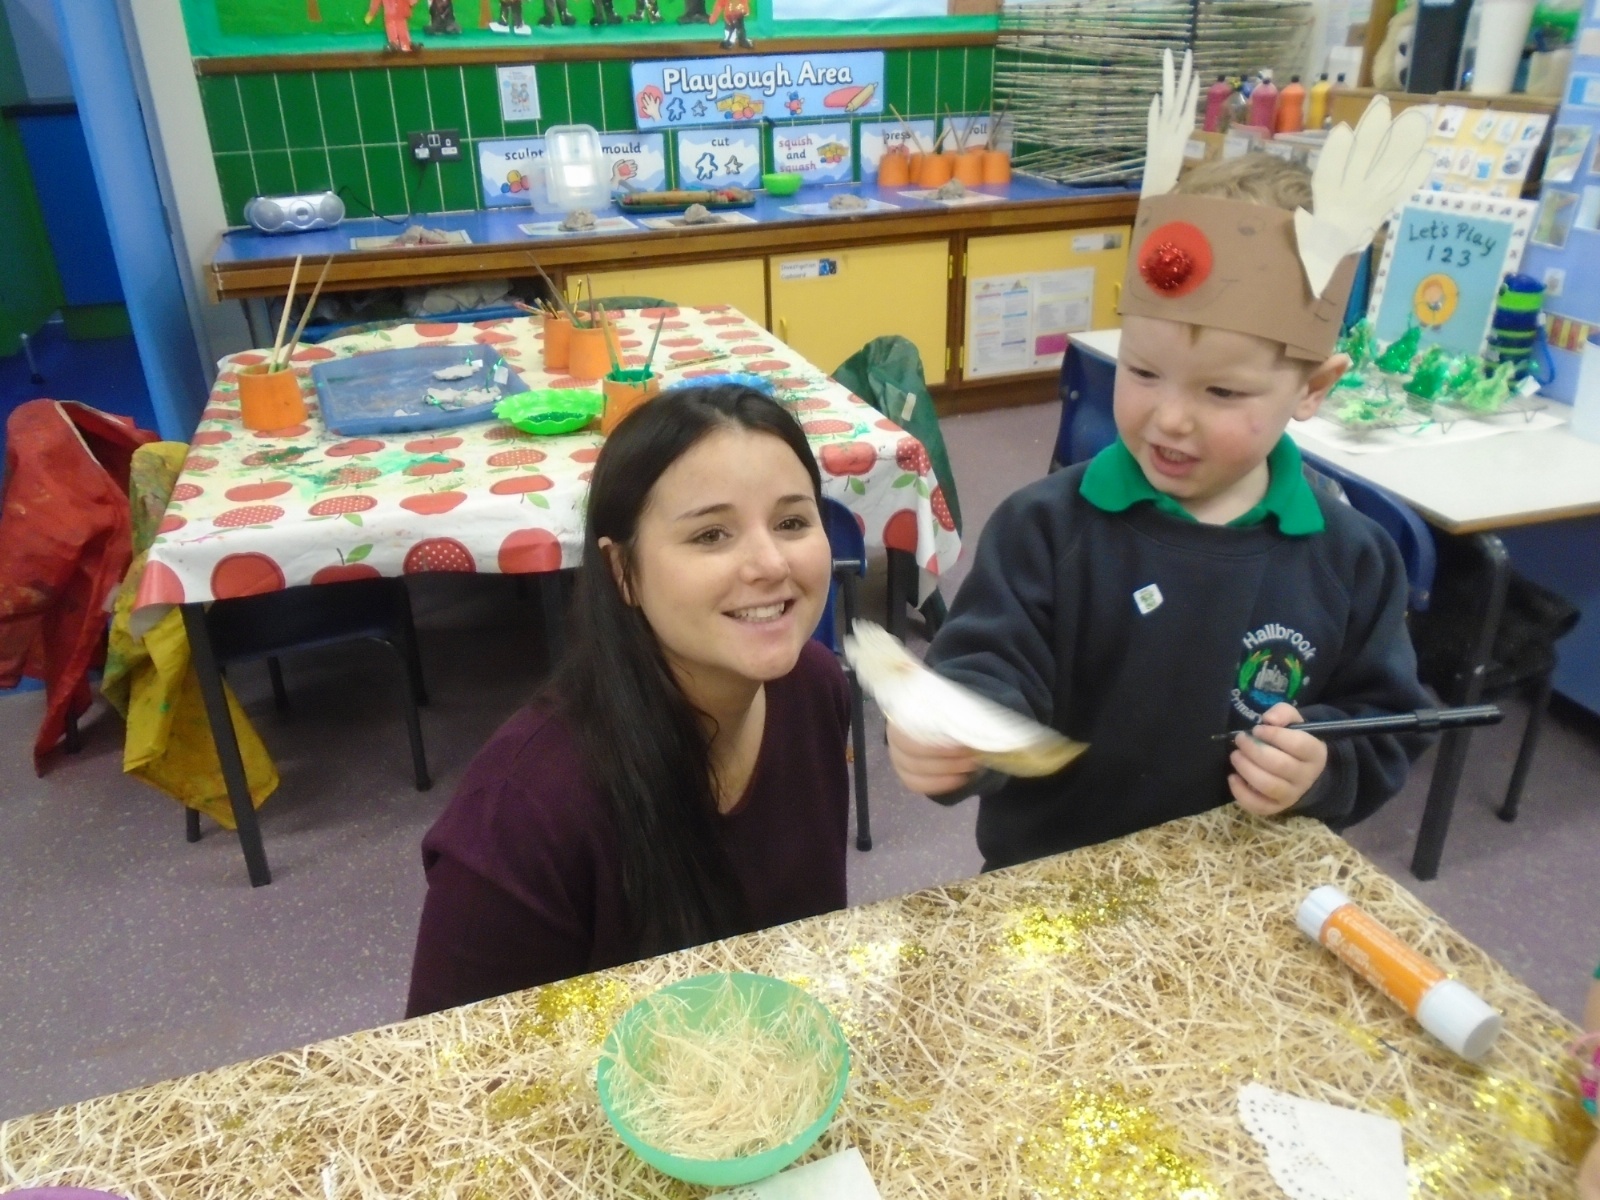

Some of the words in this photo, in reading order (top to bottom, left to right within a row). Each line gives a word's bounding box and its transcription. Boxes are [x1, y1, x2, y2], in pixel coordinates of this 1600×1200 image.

[663, 62, 792, 101] Playdough
[797, 60, 852, 86] Area
[711, 137, 730, 147] cut
[778, 135, 813, 150] squish
[883, 130, 911, 145] press
[505, 148, 543, 162] sculpt
[602, 141, 642, 155] mould
[786, 149, 807, 160] and
[779, 161, 817, 173] squash
[1408, 219, 1449, 242] Let's
[1456, 222, 1497, 257] Play
[1426, 244, 1435, 261] 1
[1440, 246, 1453, 263] 2
[1457, 249, 1472, 268] 3
[1242, 623, 1317, 660] Hallbrook
